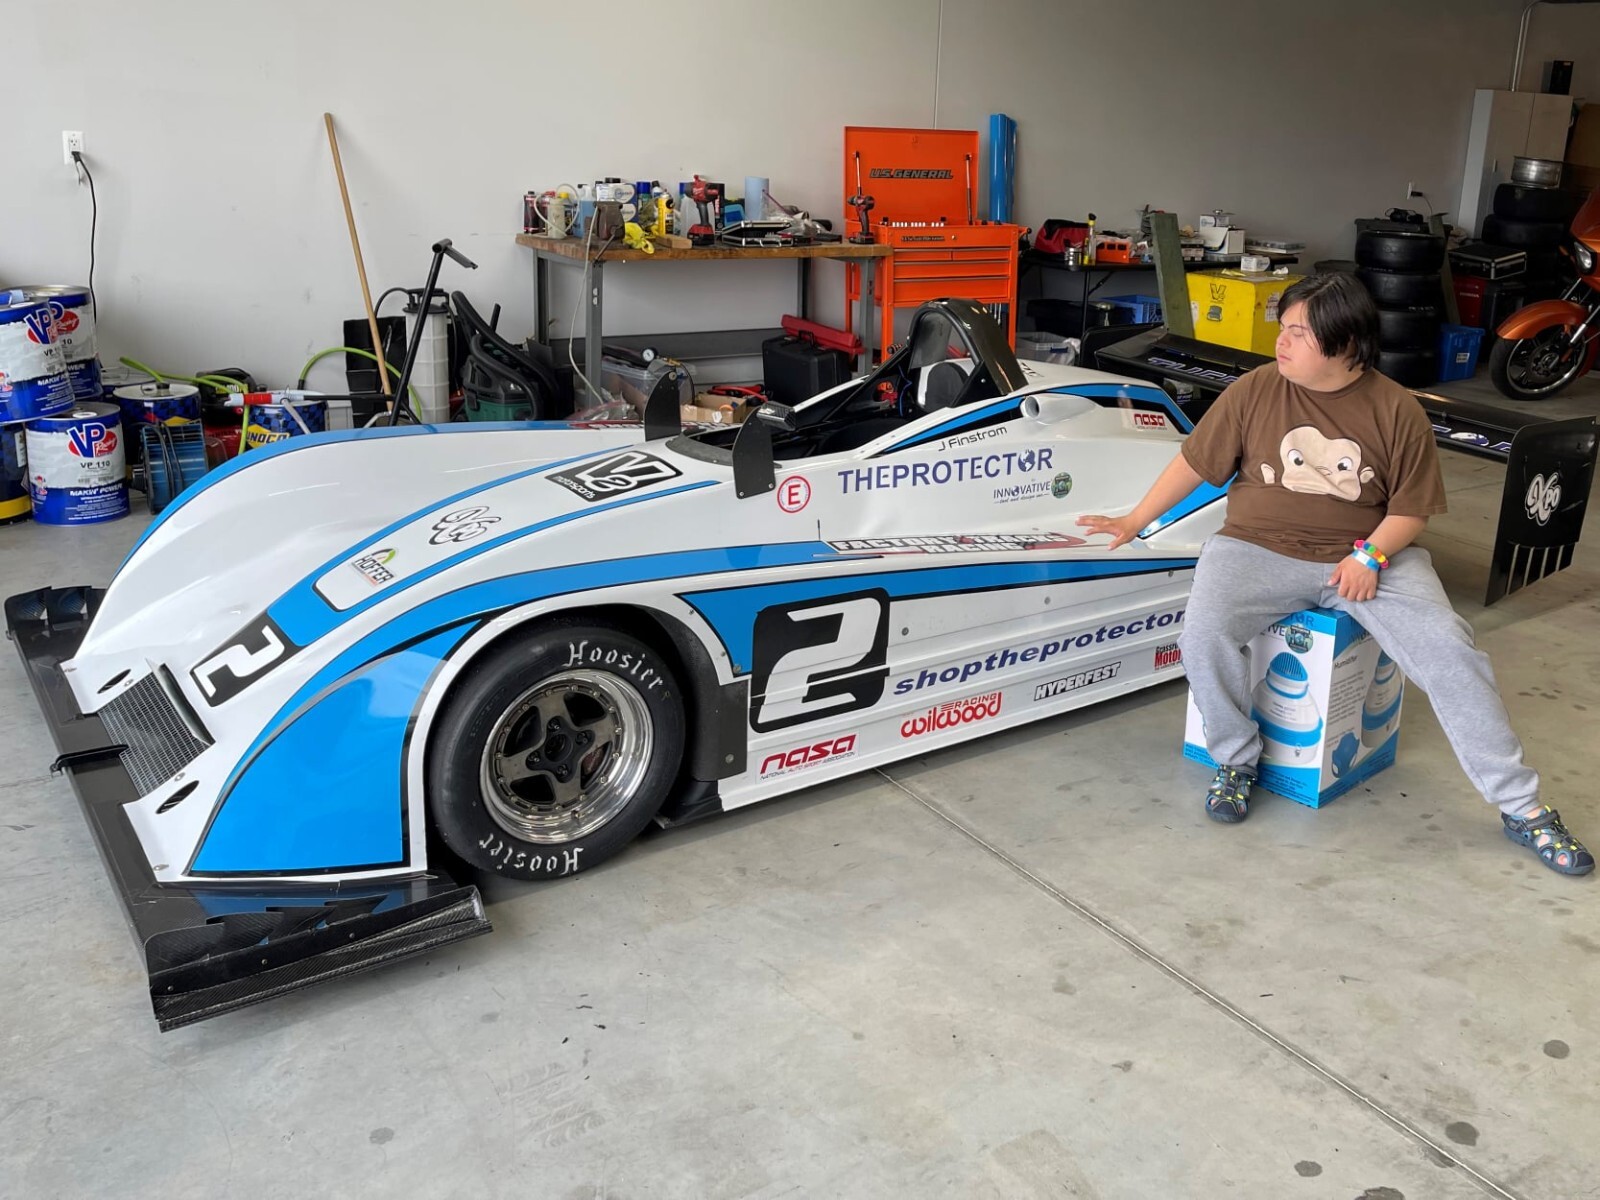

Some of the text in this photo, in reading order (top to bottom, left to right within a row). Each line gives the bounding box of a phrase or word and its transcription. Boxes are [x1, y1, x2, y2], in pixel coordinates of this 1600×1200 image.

[23, 308, 51, 345] VP
[66, 423, 106, 458] VP
[247, 432, 289, 444] NOCO
[938, 425, 1008, 451] J Finstrom
[96, 460, 111, 468] 110
[838, 448, 1053, 494] THEPROTECTOR
[788, 484, 801, 505] E
[993, 481, 1051, 499] INNOVATIVE
[833, 536, 957, 550] FACTORY
[923, 542, 1022, 554] RACING
[354, 555, 394, 584] HOFFER
[193, 625, 285, 698] 2
[562, 640, 663, 690] Hoosier
[758, 597, 881, 724] 2
[1034, 662, 1121, 701] HYPERFEST
[900, 692, 1002, 737] wilwood
[954, 692, 997, 709] RACING
[478, 833, 584, 875] Hoosier
